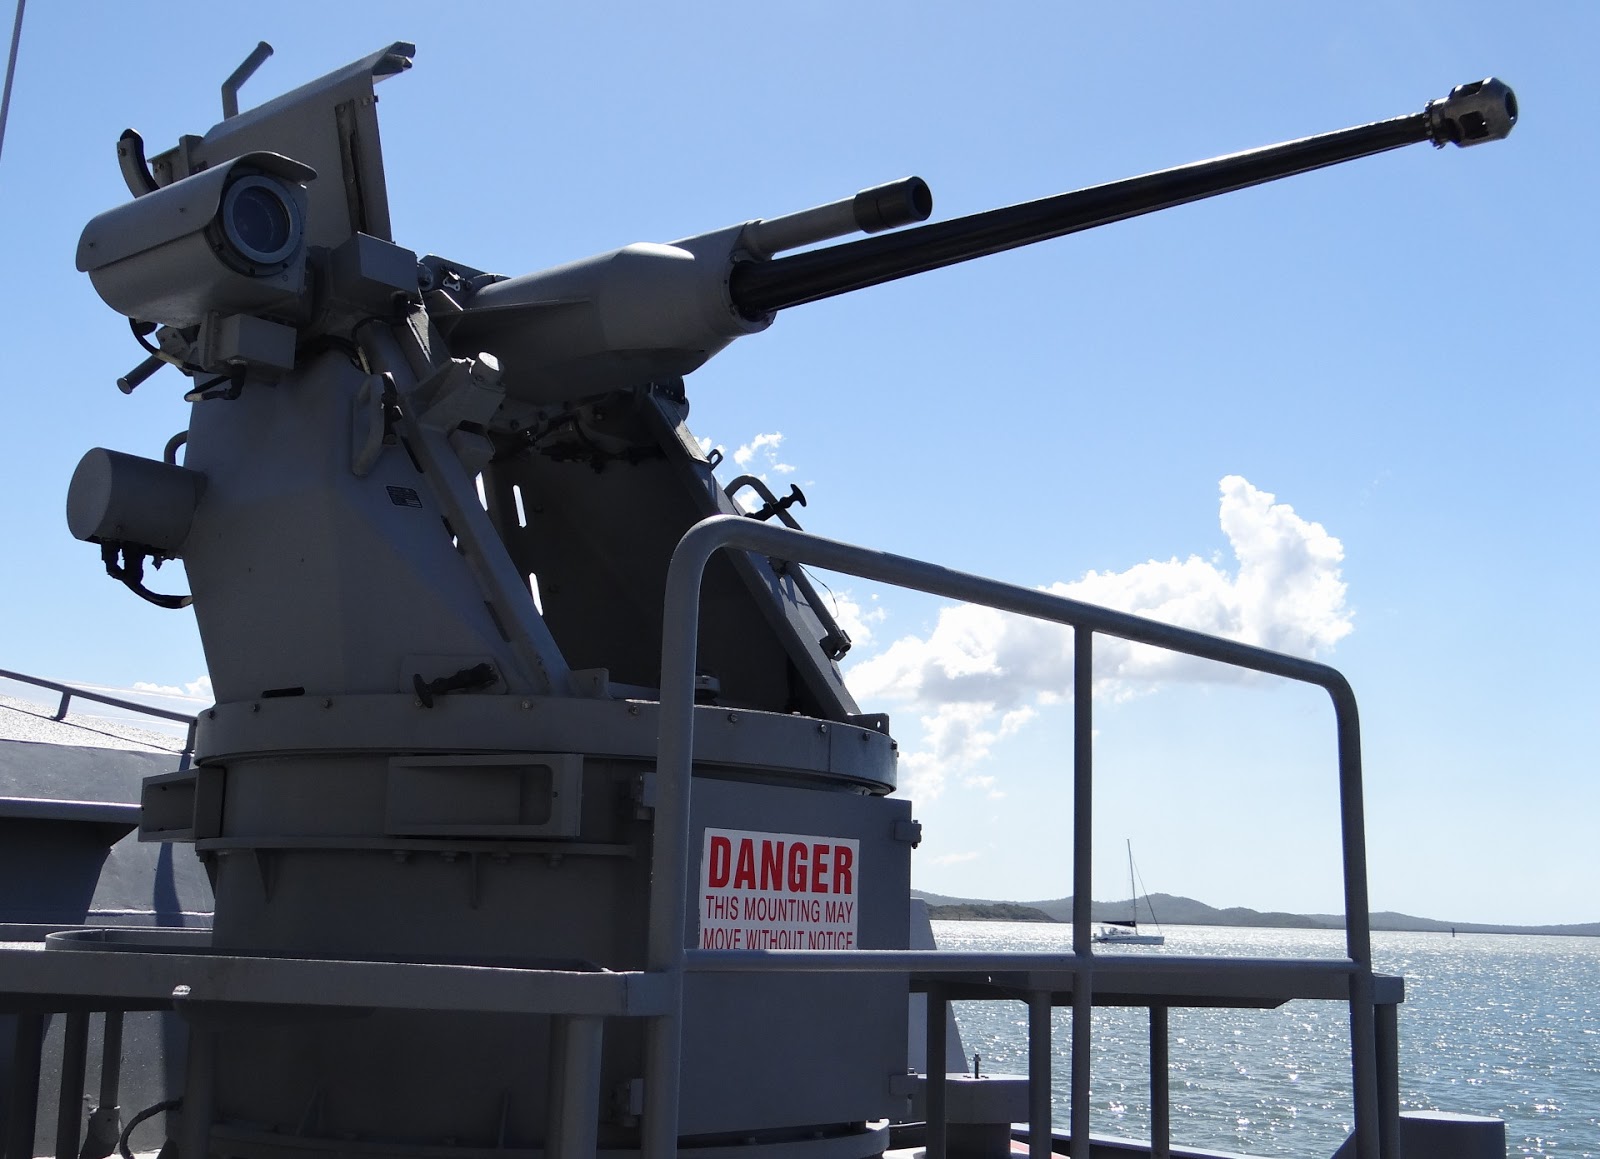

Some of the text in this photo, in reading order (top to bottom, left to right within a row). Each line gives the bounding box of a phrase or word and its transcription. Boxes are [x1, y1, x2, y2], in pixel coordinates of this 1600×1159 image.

[708, 836, 853, 894] DANGER
[706, 895, 854, 923] THIS MOUNTING MAY
[703, 928, 853, 950] MOVE WITHOUT NOTICE
